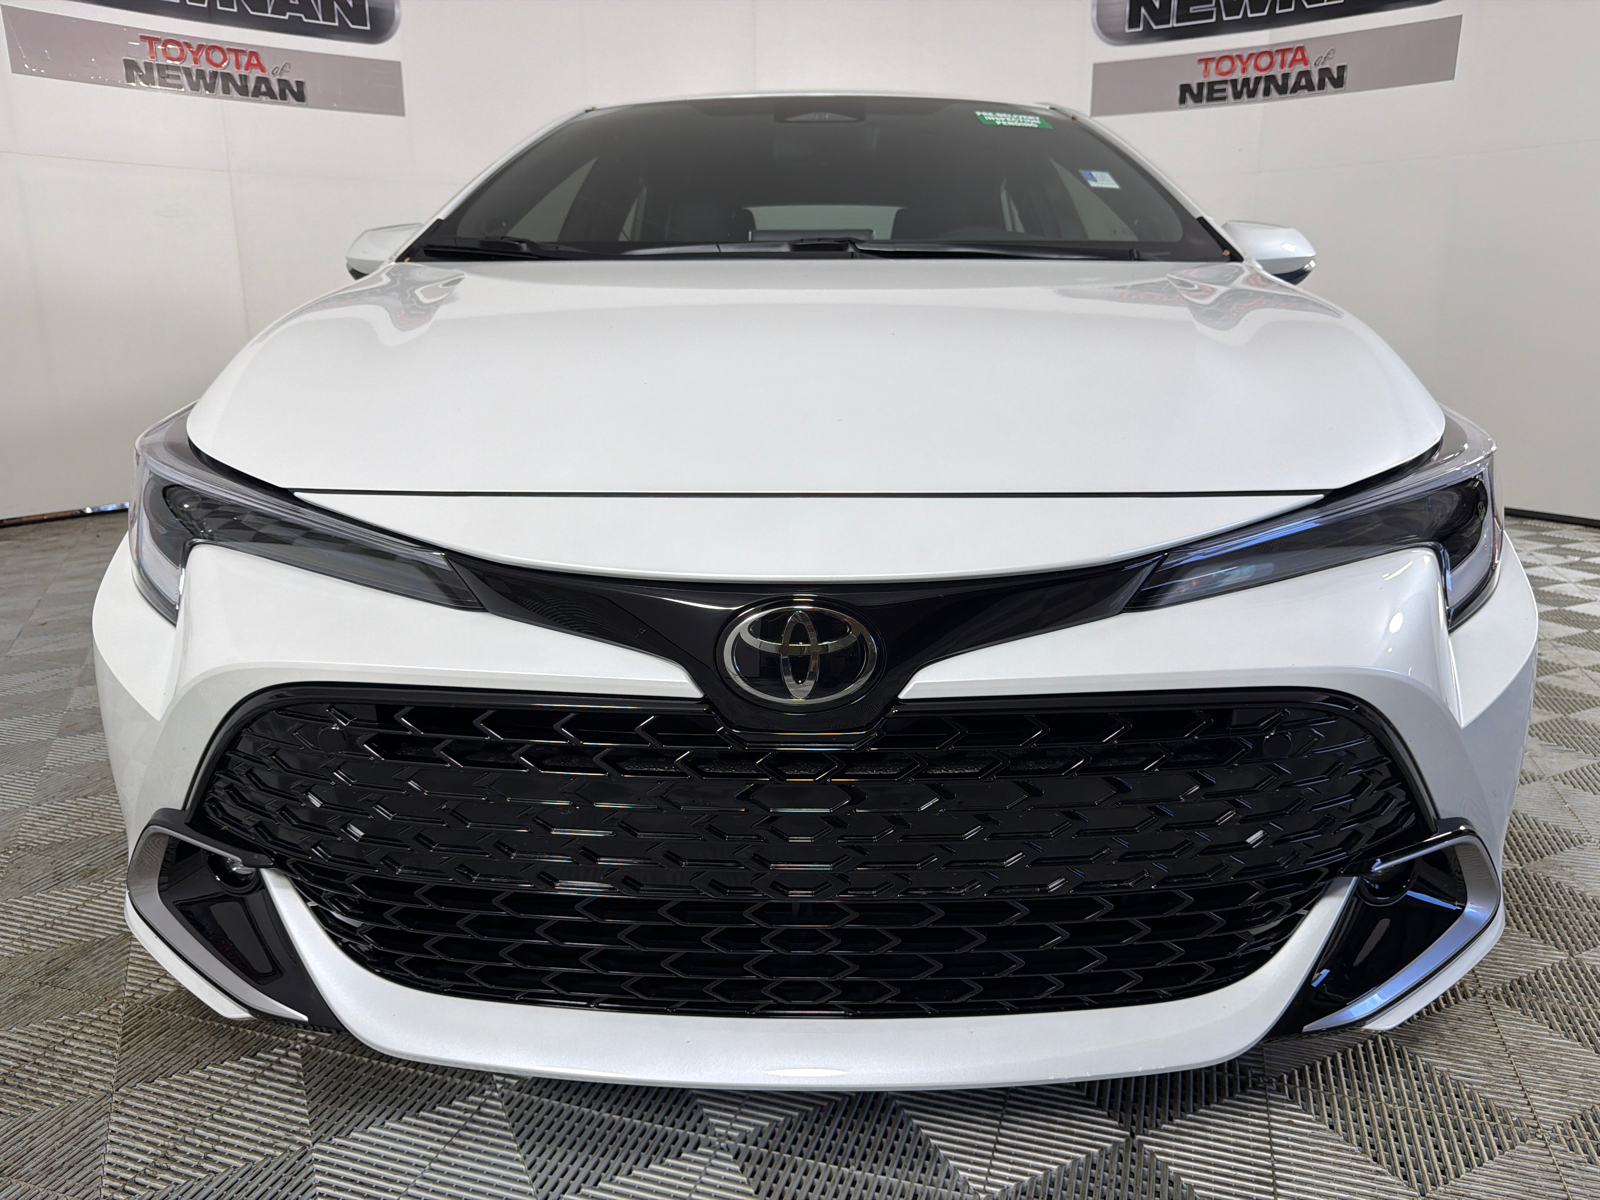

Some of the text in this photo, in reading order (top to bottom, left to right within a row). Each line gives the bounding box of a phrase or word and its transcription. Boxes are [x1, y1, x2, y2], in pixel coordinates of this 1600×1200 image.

[140, 35, 291, 76] TOYOTA of
[1197, 46, 1334, 79] TOYOTA of
[123, 59, 306, 103] NEWNAN
[1179, 65, 1347, 106] NEWNAN
